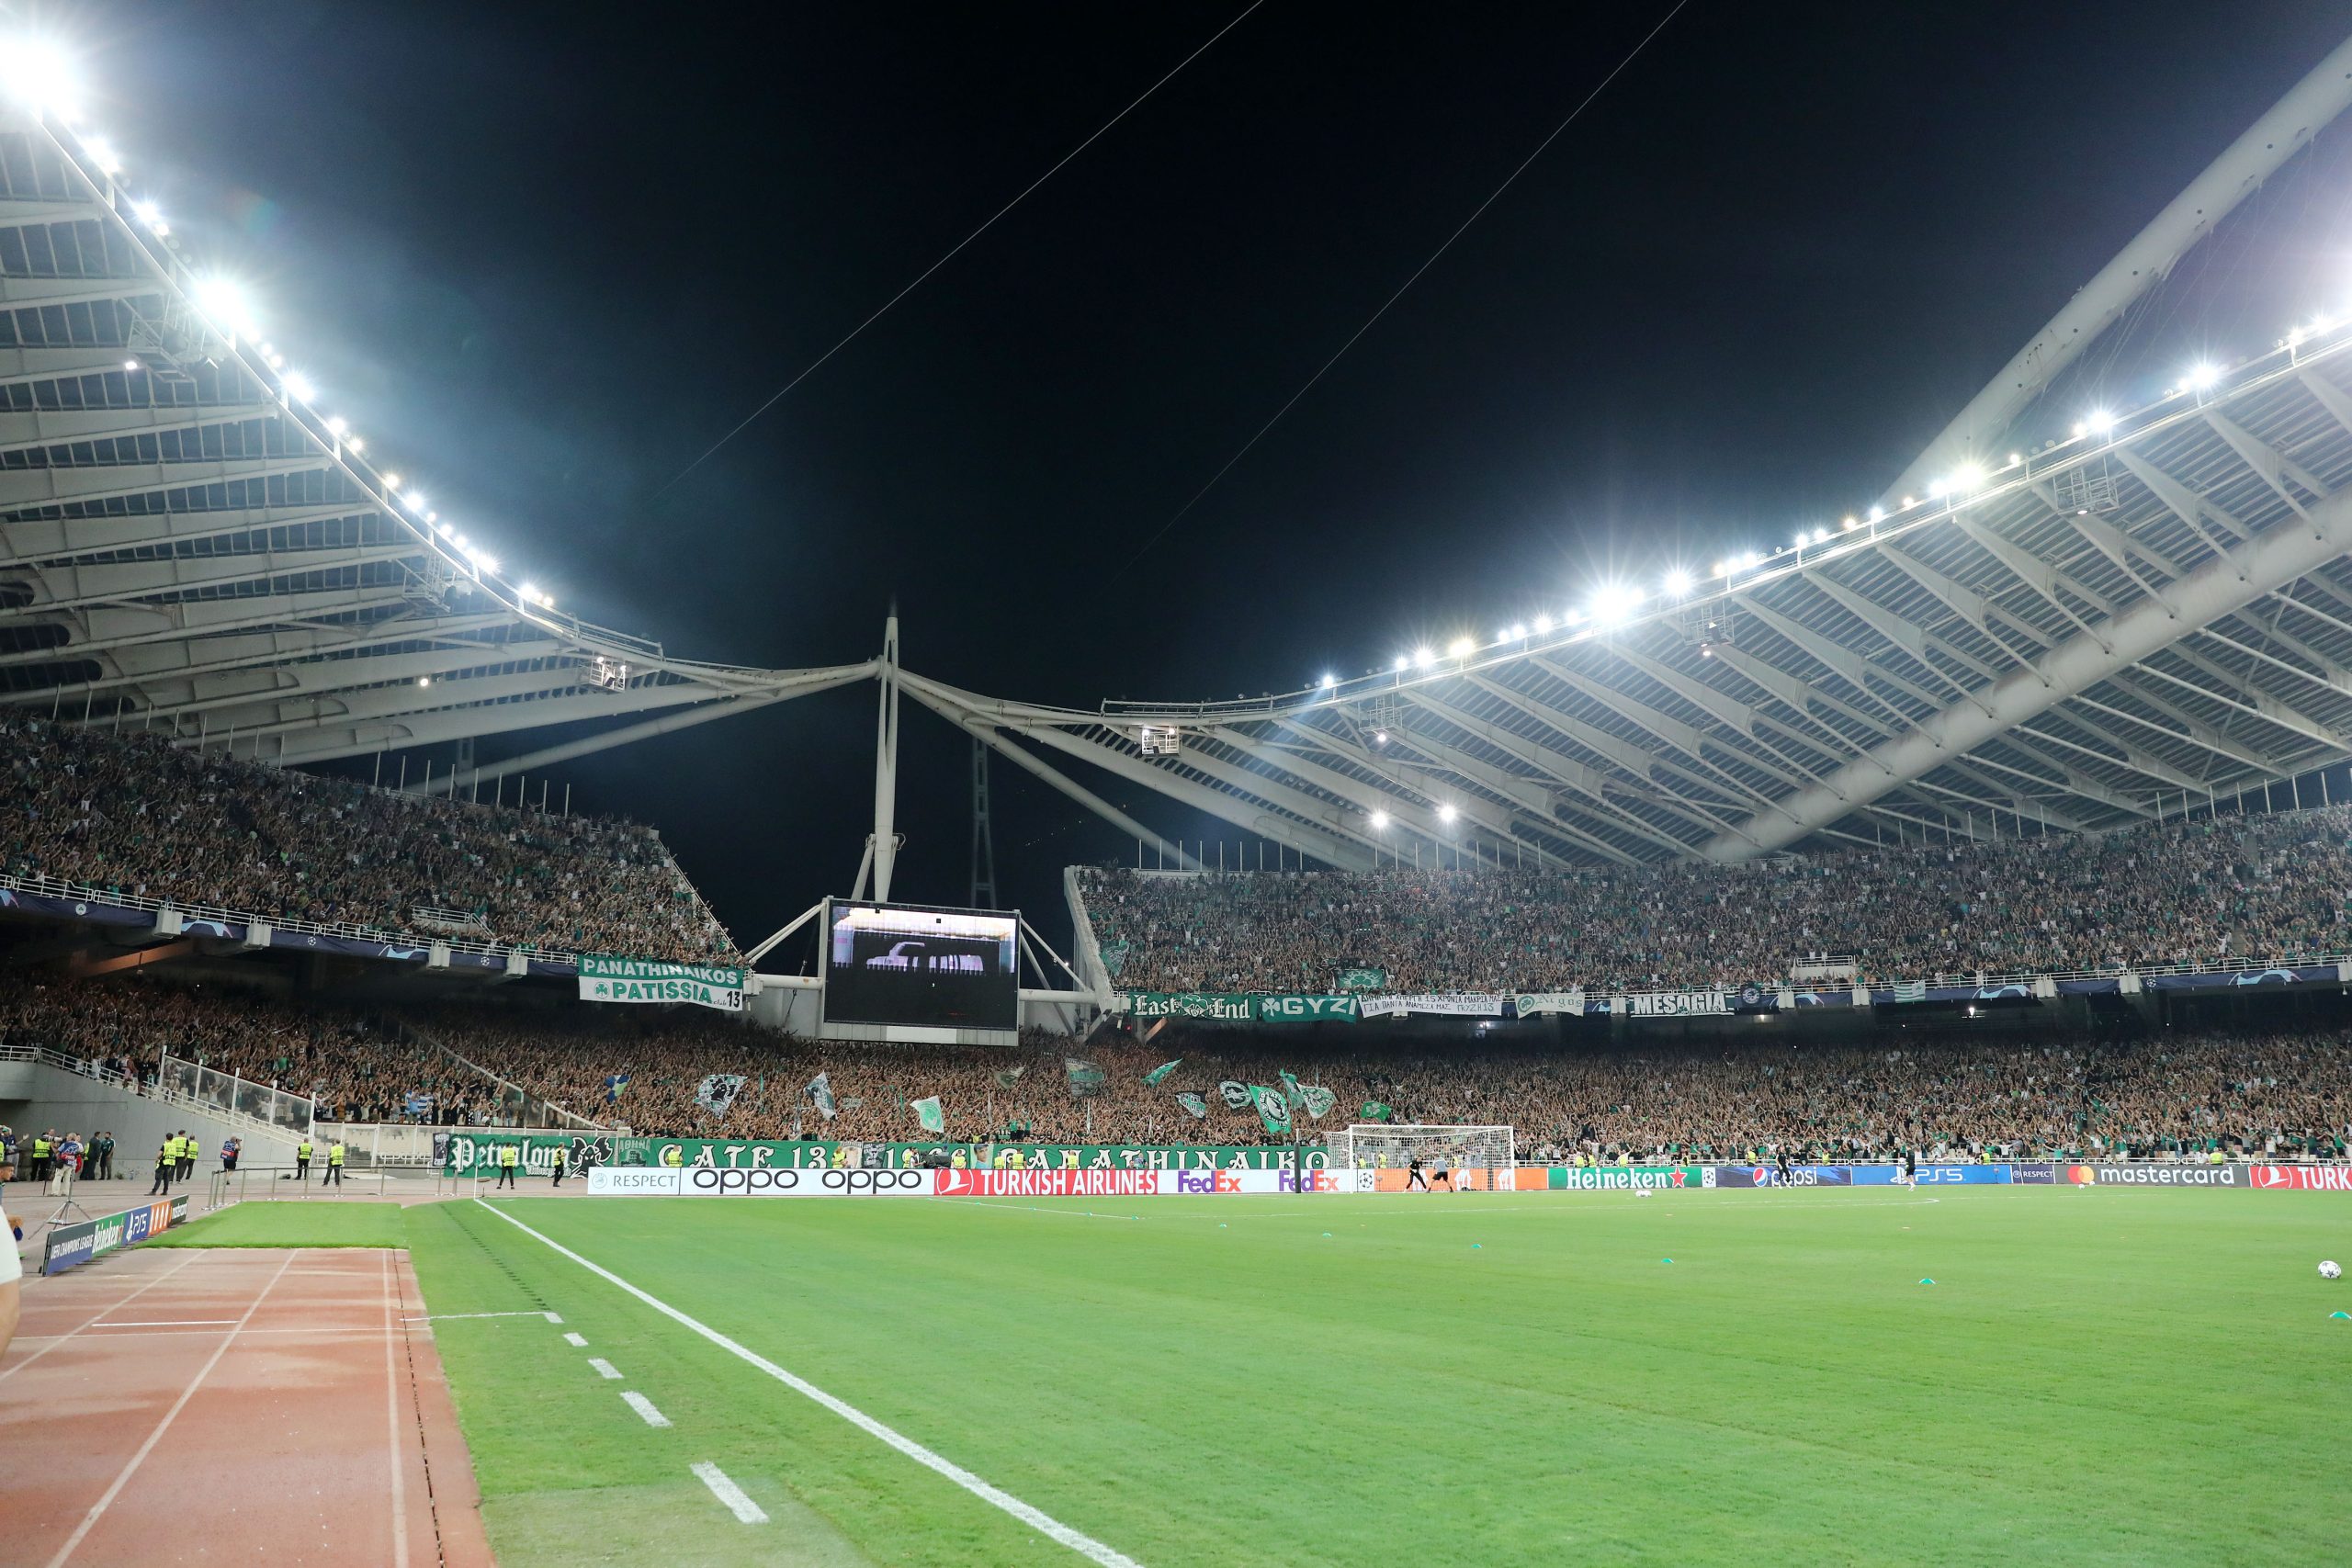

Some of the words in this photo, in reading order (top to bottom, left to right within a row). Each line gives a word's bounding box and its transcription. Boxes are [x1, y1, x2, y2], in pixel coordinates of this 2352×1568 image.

[583, 958, 738, 985] PANATHINAIKOS
[613, 981, 713, 1004] PATISSIA
[727, 990, 741, 1009] 13
[1283, 997, 1358, 1016] GYZI
[1634, 992, 1727, 1015] MESOGIA
[1135, 995, 1178, 1016] East
[1211, 998, 1250, 1019] End
[791, 1145, 828, 1168] 13
[613, 1175, 677, 1188] RESPECT
[693, 1169, 798, 1194] oppo
[821, 1169, 922, 1194] oppo
[980, 1169, 1067, 1195] TURKISH
[1072, 1169, 1156, 1195] AIRLINES
[1177, 1170, 1242, 1193] FedEx
[1566, 1168, 1668, 1190] Heineken
[1915, 1168, 1963, 1182] PS5
[2100, 1165, 2235, 1184] mastercard
[2299, 1167, 2352, 1190] TURK
[133, 1213, 147, 1235] PS5
[51, 1243, 61, 1260] UEFA
[60, 1237, 80, 1258] CHAMPIONS
[80, 1234, 94, 1250] LEAGUE
[92, 1220, 119, 1254] Heineken
